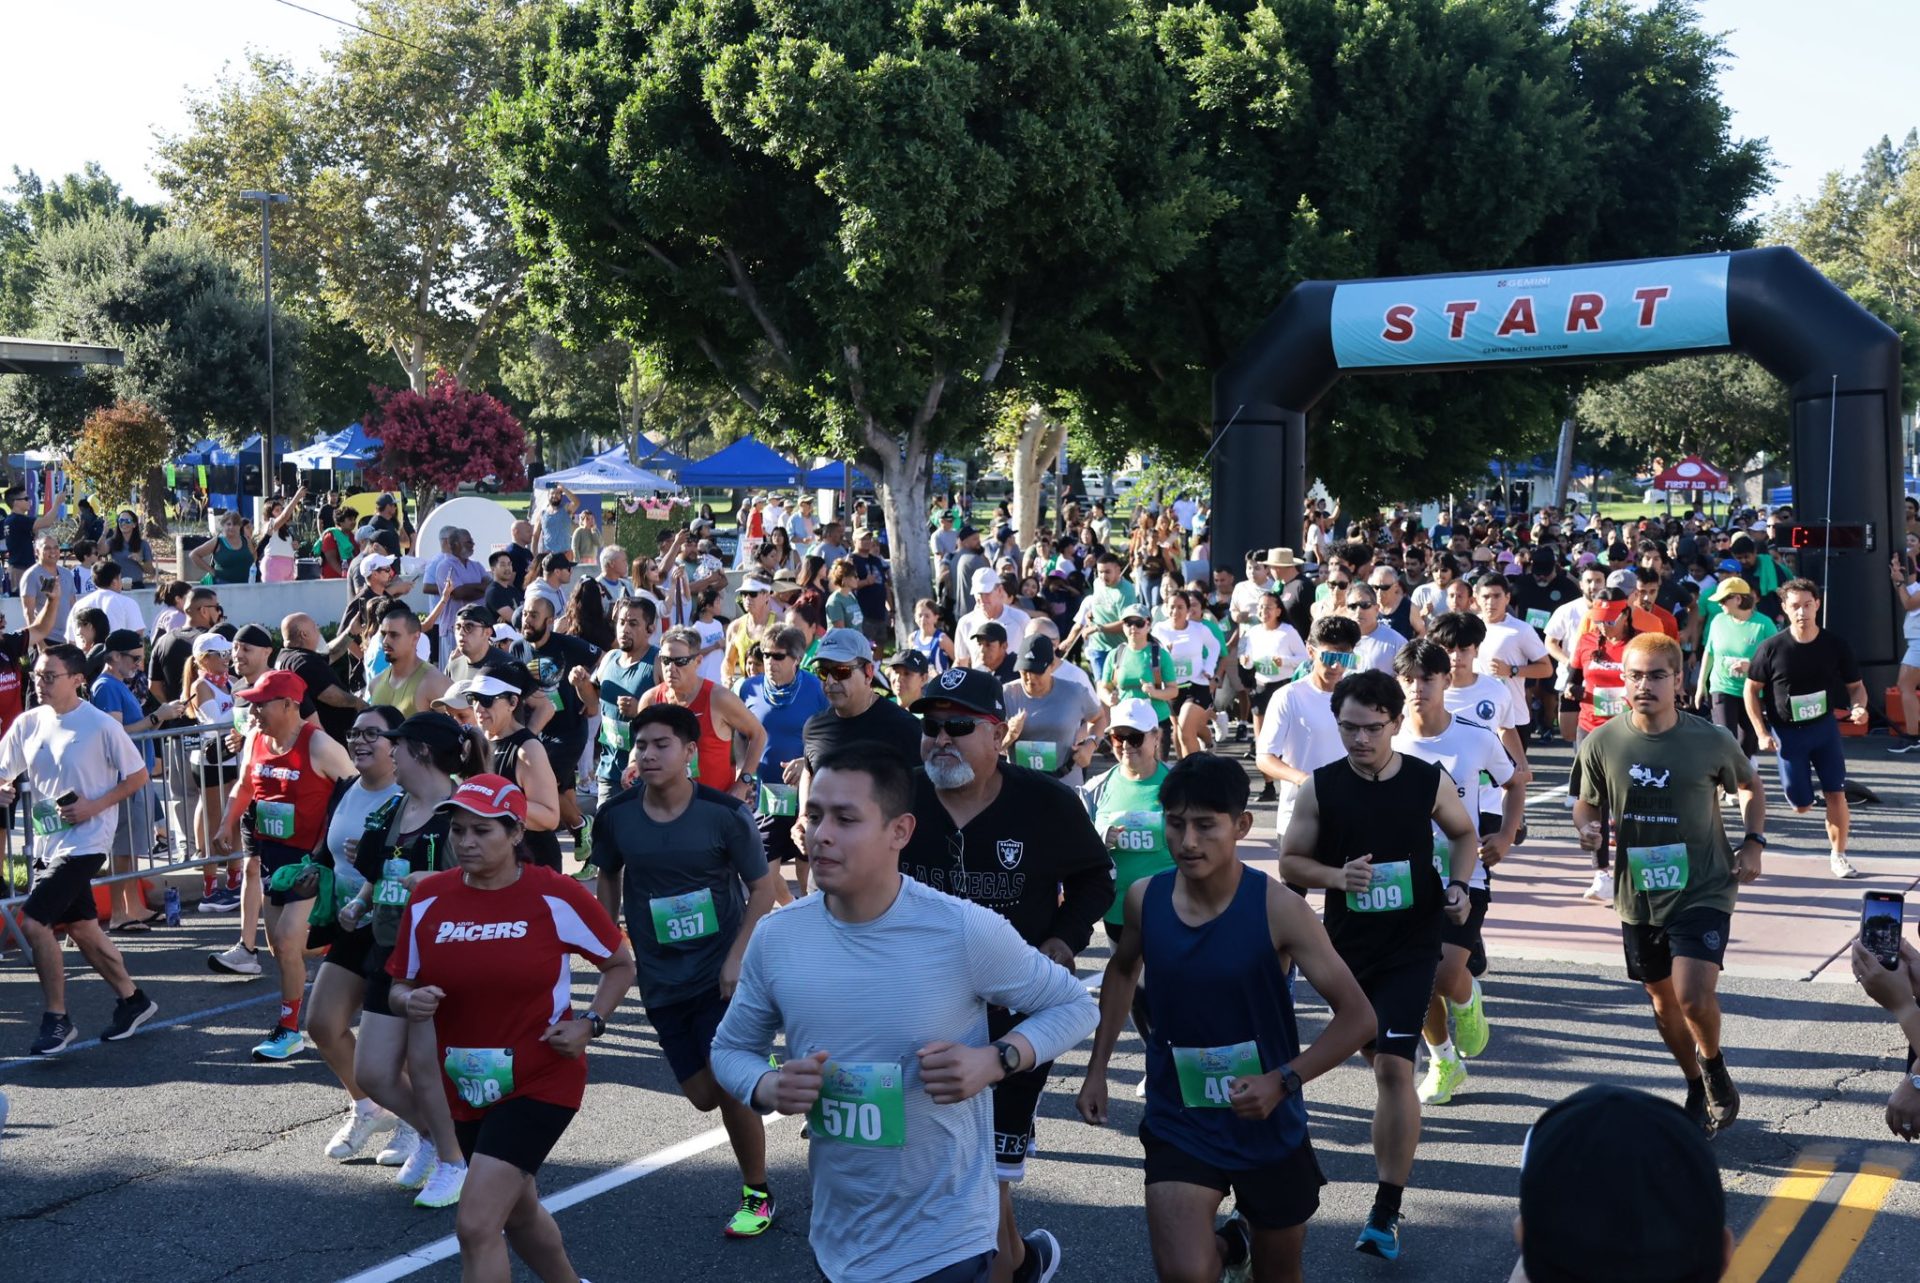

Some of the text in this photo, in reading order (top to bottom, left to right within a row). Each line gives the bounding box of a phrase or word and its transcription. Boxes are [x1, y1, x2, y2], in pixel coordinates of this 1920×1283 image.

[1507, 277, 1551, 288] GEMINI
[1380, 285, 1672, 343] START
[1664, 480, 1690, 489] FIRST
[1691, 480, 1707, 490] AID
[1600, 700, 1624, 715] 315
[1799, 703, 1823, 719] 632
[251, 763, 301, 781] PACERS
[1028, 755, 1045, 770] 18
[456, 782, 495, 797] PACERS
[263, 817, 285, 837] 116
[1656, 816, 1679, 824] INVITE
[1117, 830, 1154, 850] 665
[948, 870, 1026, 900] VEGAS
[1641, 865, 1681, 889] 352
[1357, 884, 1403, 911] 509
[434, 920, 528, 944] PACERS
[666, 911, 705, 940] 357
[822, 1097, 882, 1141] 570
